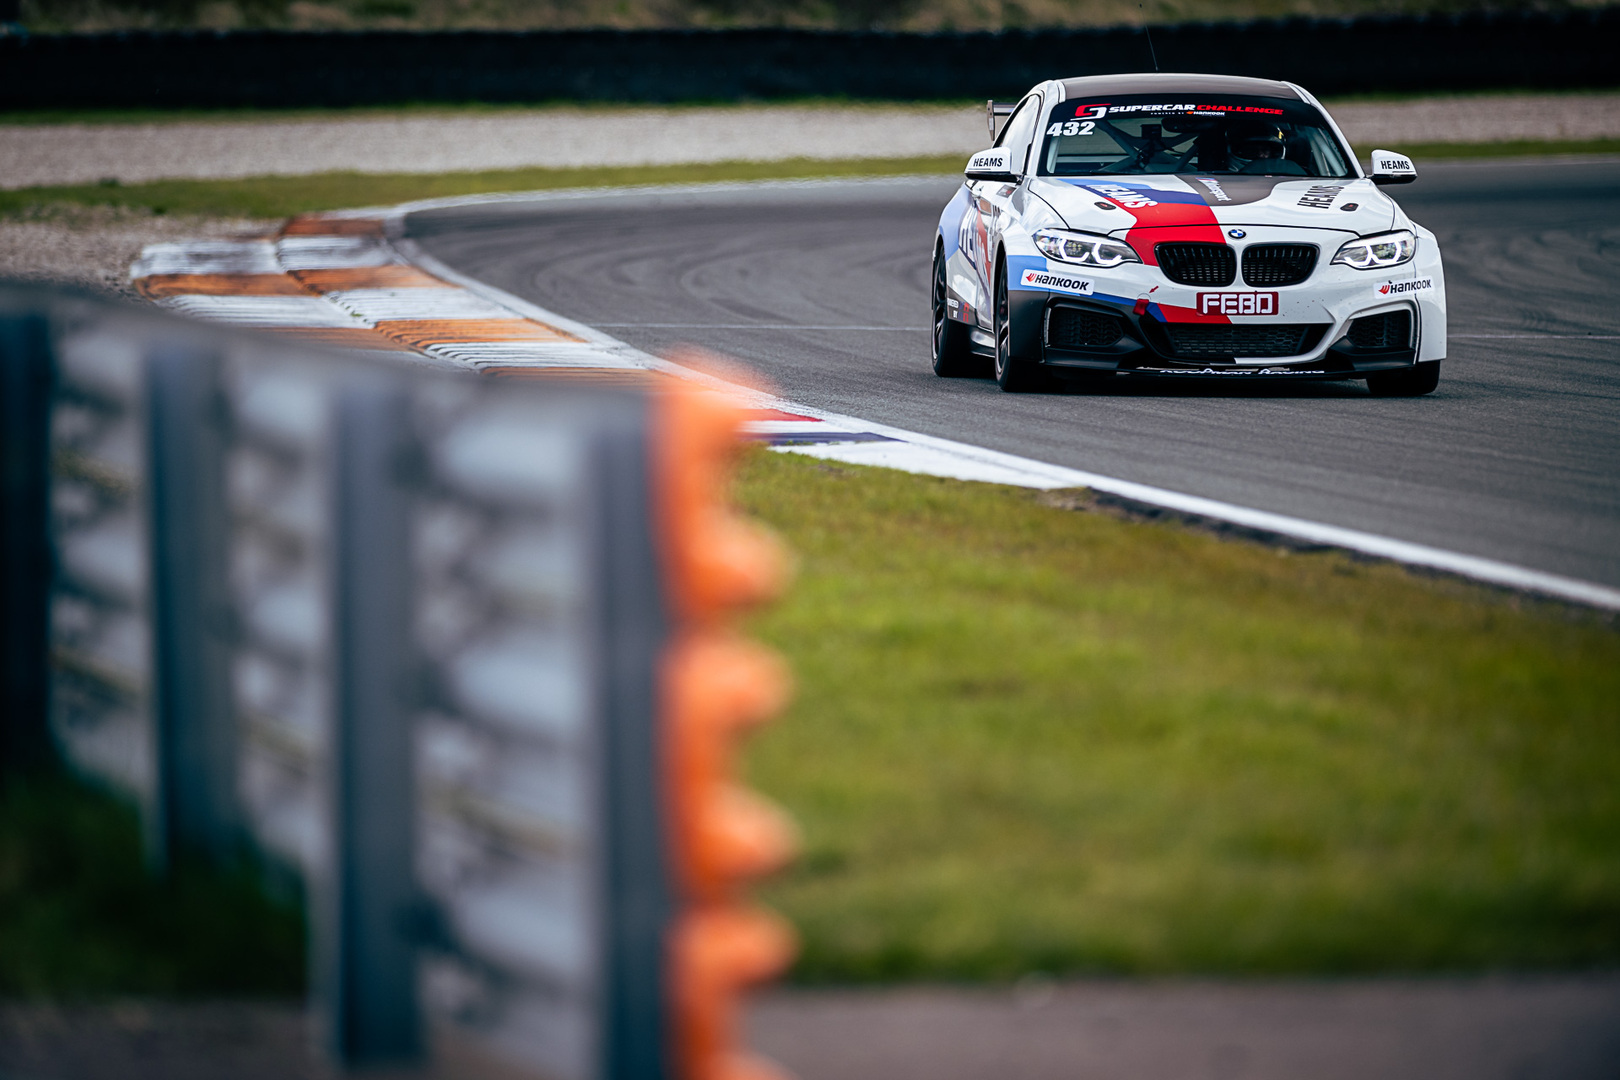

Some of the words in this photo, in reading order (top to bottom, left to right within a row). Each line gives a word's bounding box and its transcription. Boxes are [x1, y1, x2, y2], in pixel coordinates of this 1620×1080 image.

[1109, 104, 1195, 113] SUPERCAR
[1197, 104, 1284, 115] CHALLENGE
[1046, 121, 1096, 136] 432
[973, 157, 1003, 167] HEAMS
[1380, 160, 1410, 170] HEAMS
[1086, 184, 1158, 208] HEAMS
[1297, 185, 1344, 209] HEAMS
[1202, 293, 1273, 314] FEBO
